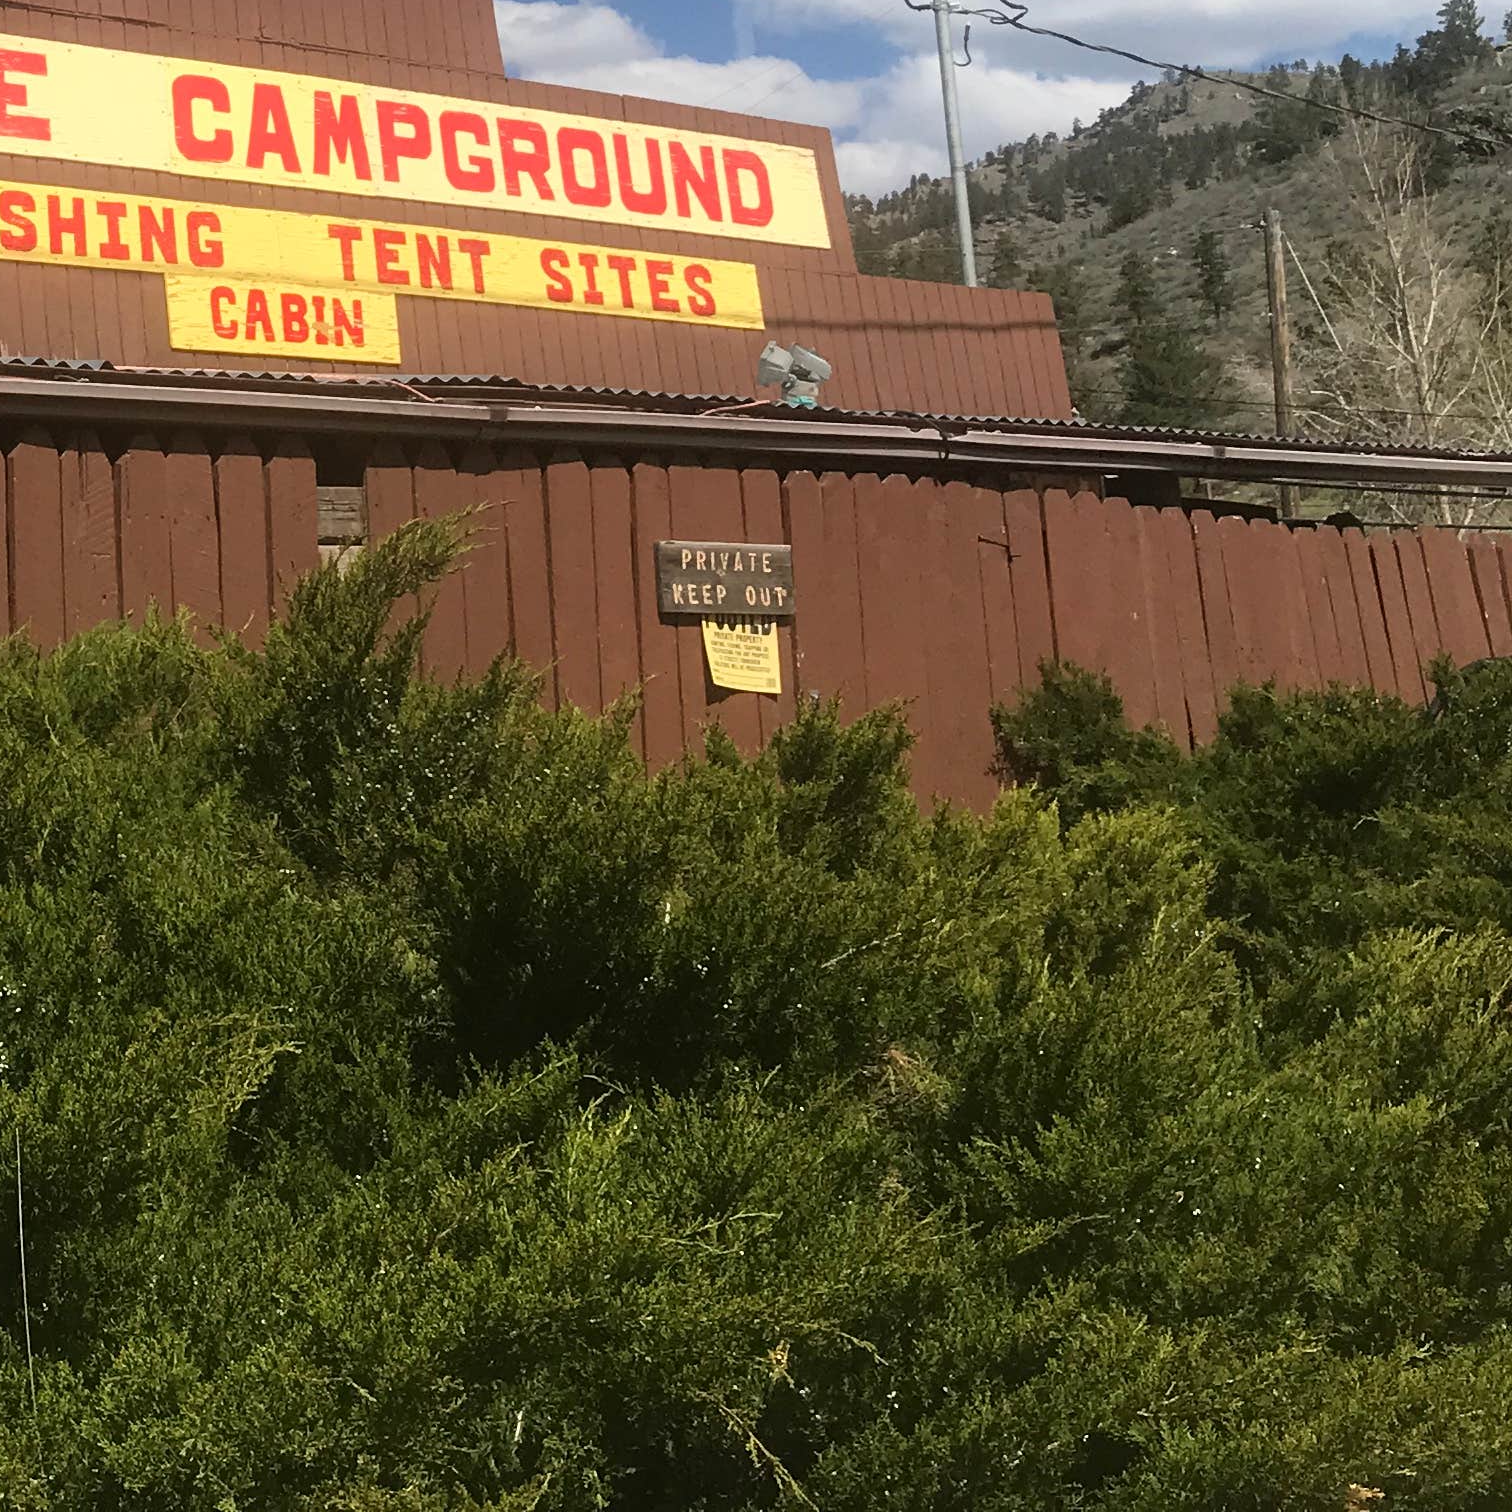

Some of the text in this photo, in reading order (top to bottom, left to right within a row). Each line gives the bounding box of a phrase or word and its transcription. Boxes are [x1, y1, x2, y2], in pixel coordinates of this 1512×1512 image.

[172, 75, 774, 227] CAMPGROUND
[328, 224, 490, 294] TENT
[540, 248, 716, 317] SITES
[210, 286, 364, 347] CABIN
[681, 549, 772, 573] PRIVATE
[672, 583, 787, 607] KEEP OUT
